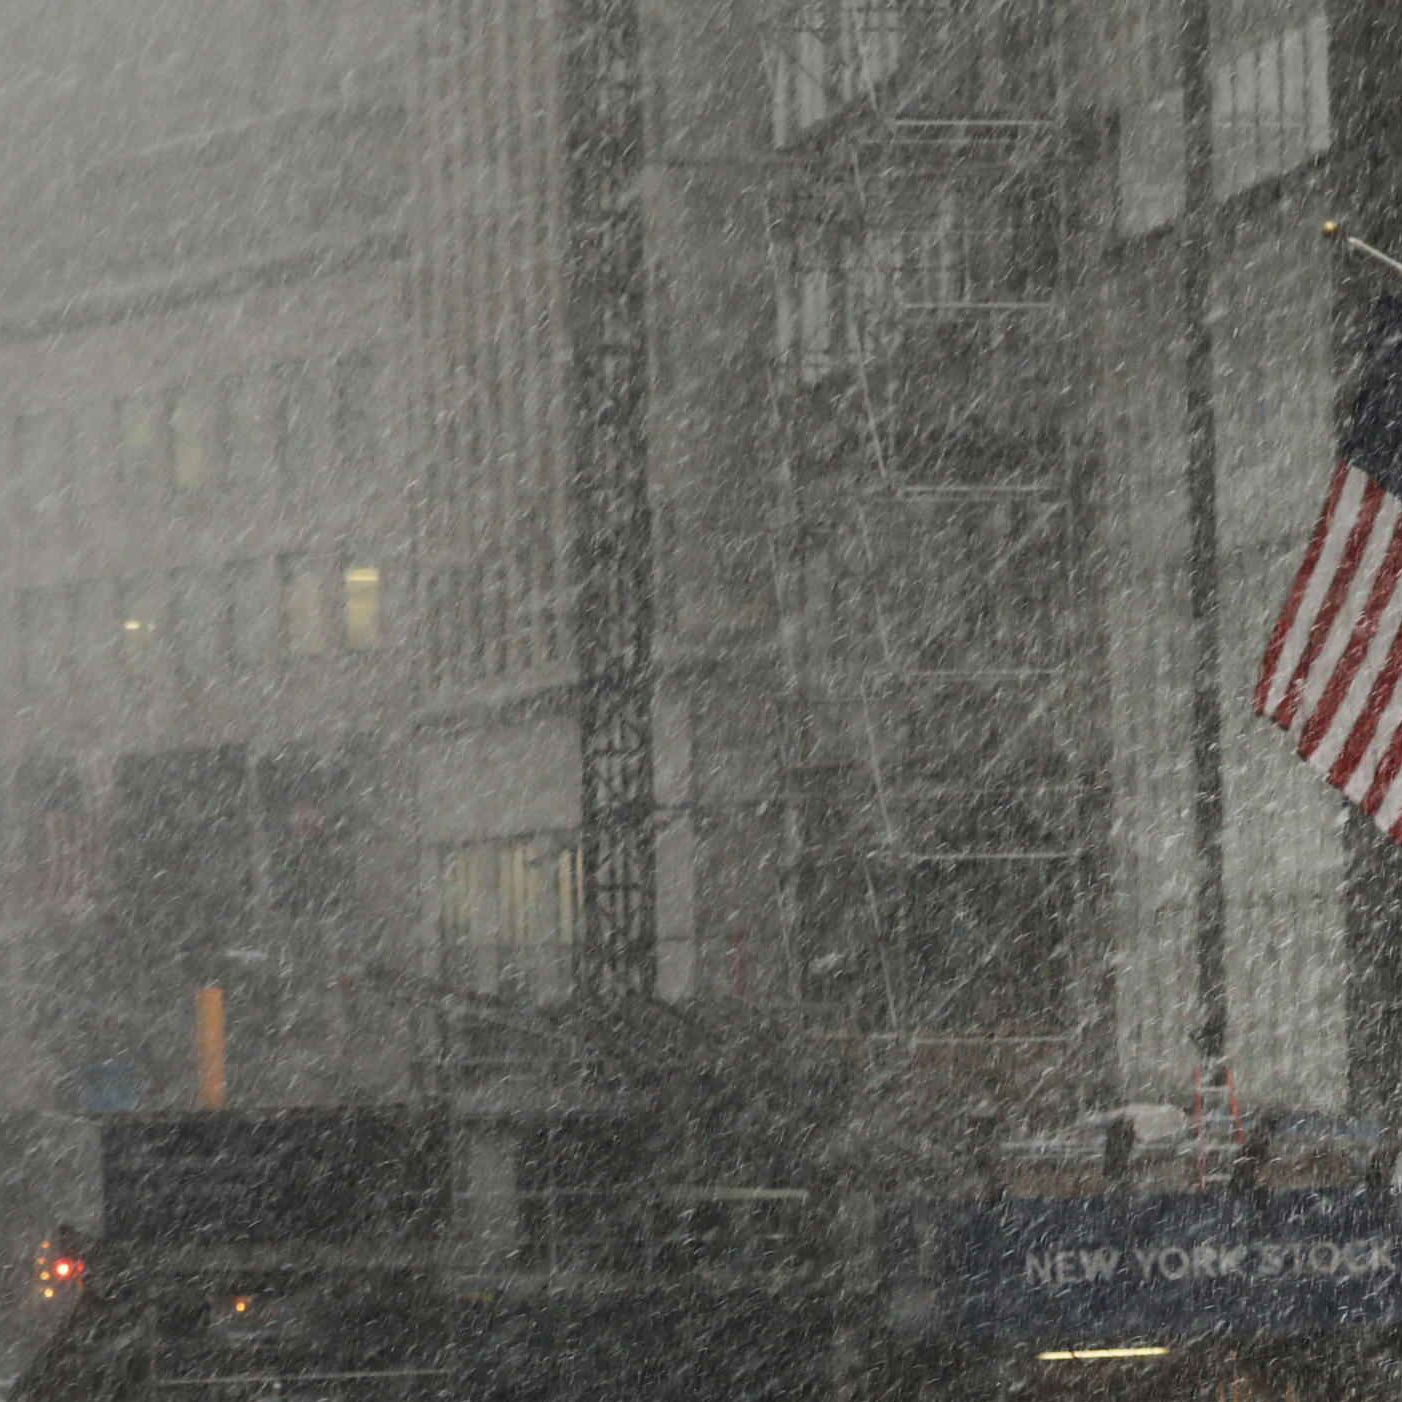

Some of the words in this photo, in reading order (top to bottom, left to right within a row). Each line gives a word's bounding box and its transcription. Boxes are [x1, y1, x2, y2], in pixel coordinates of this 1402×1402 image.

[1025, 1249, 1123, 1285] NEW
[1133, 1246, 1249, 1281] YORK
[1257, 1239, 1397, 1276] STOCK
